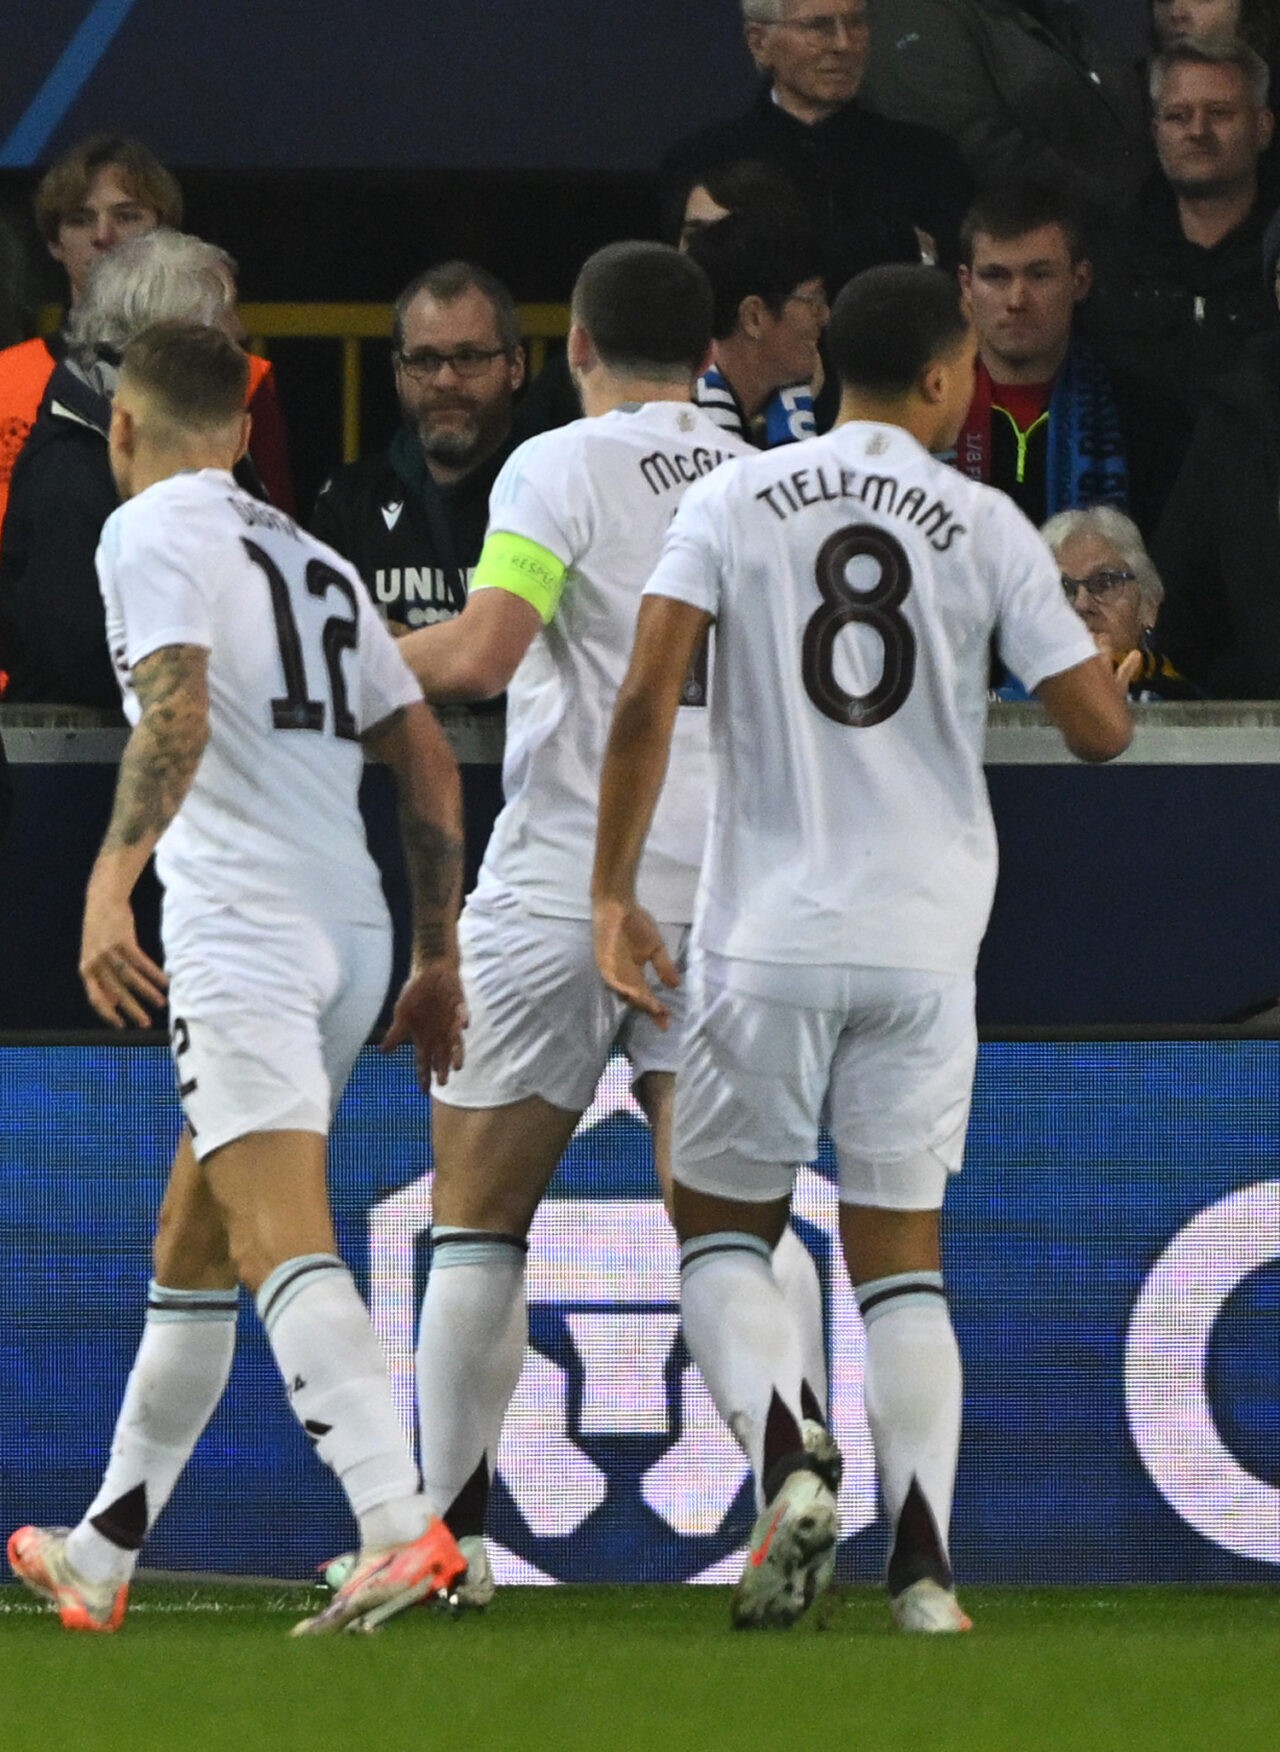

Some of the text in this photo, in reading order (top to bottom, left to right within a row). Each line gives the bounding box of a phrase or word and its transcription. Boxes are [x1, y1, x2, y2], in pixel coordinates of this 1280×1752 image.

[639, 446, 736, 495] McG
[755, 467, 966, 552] TIELEMANS
[238, 535, 362, 743] 12
[801, 522, 918, 728] 8
